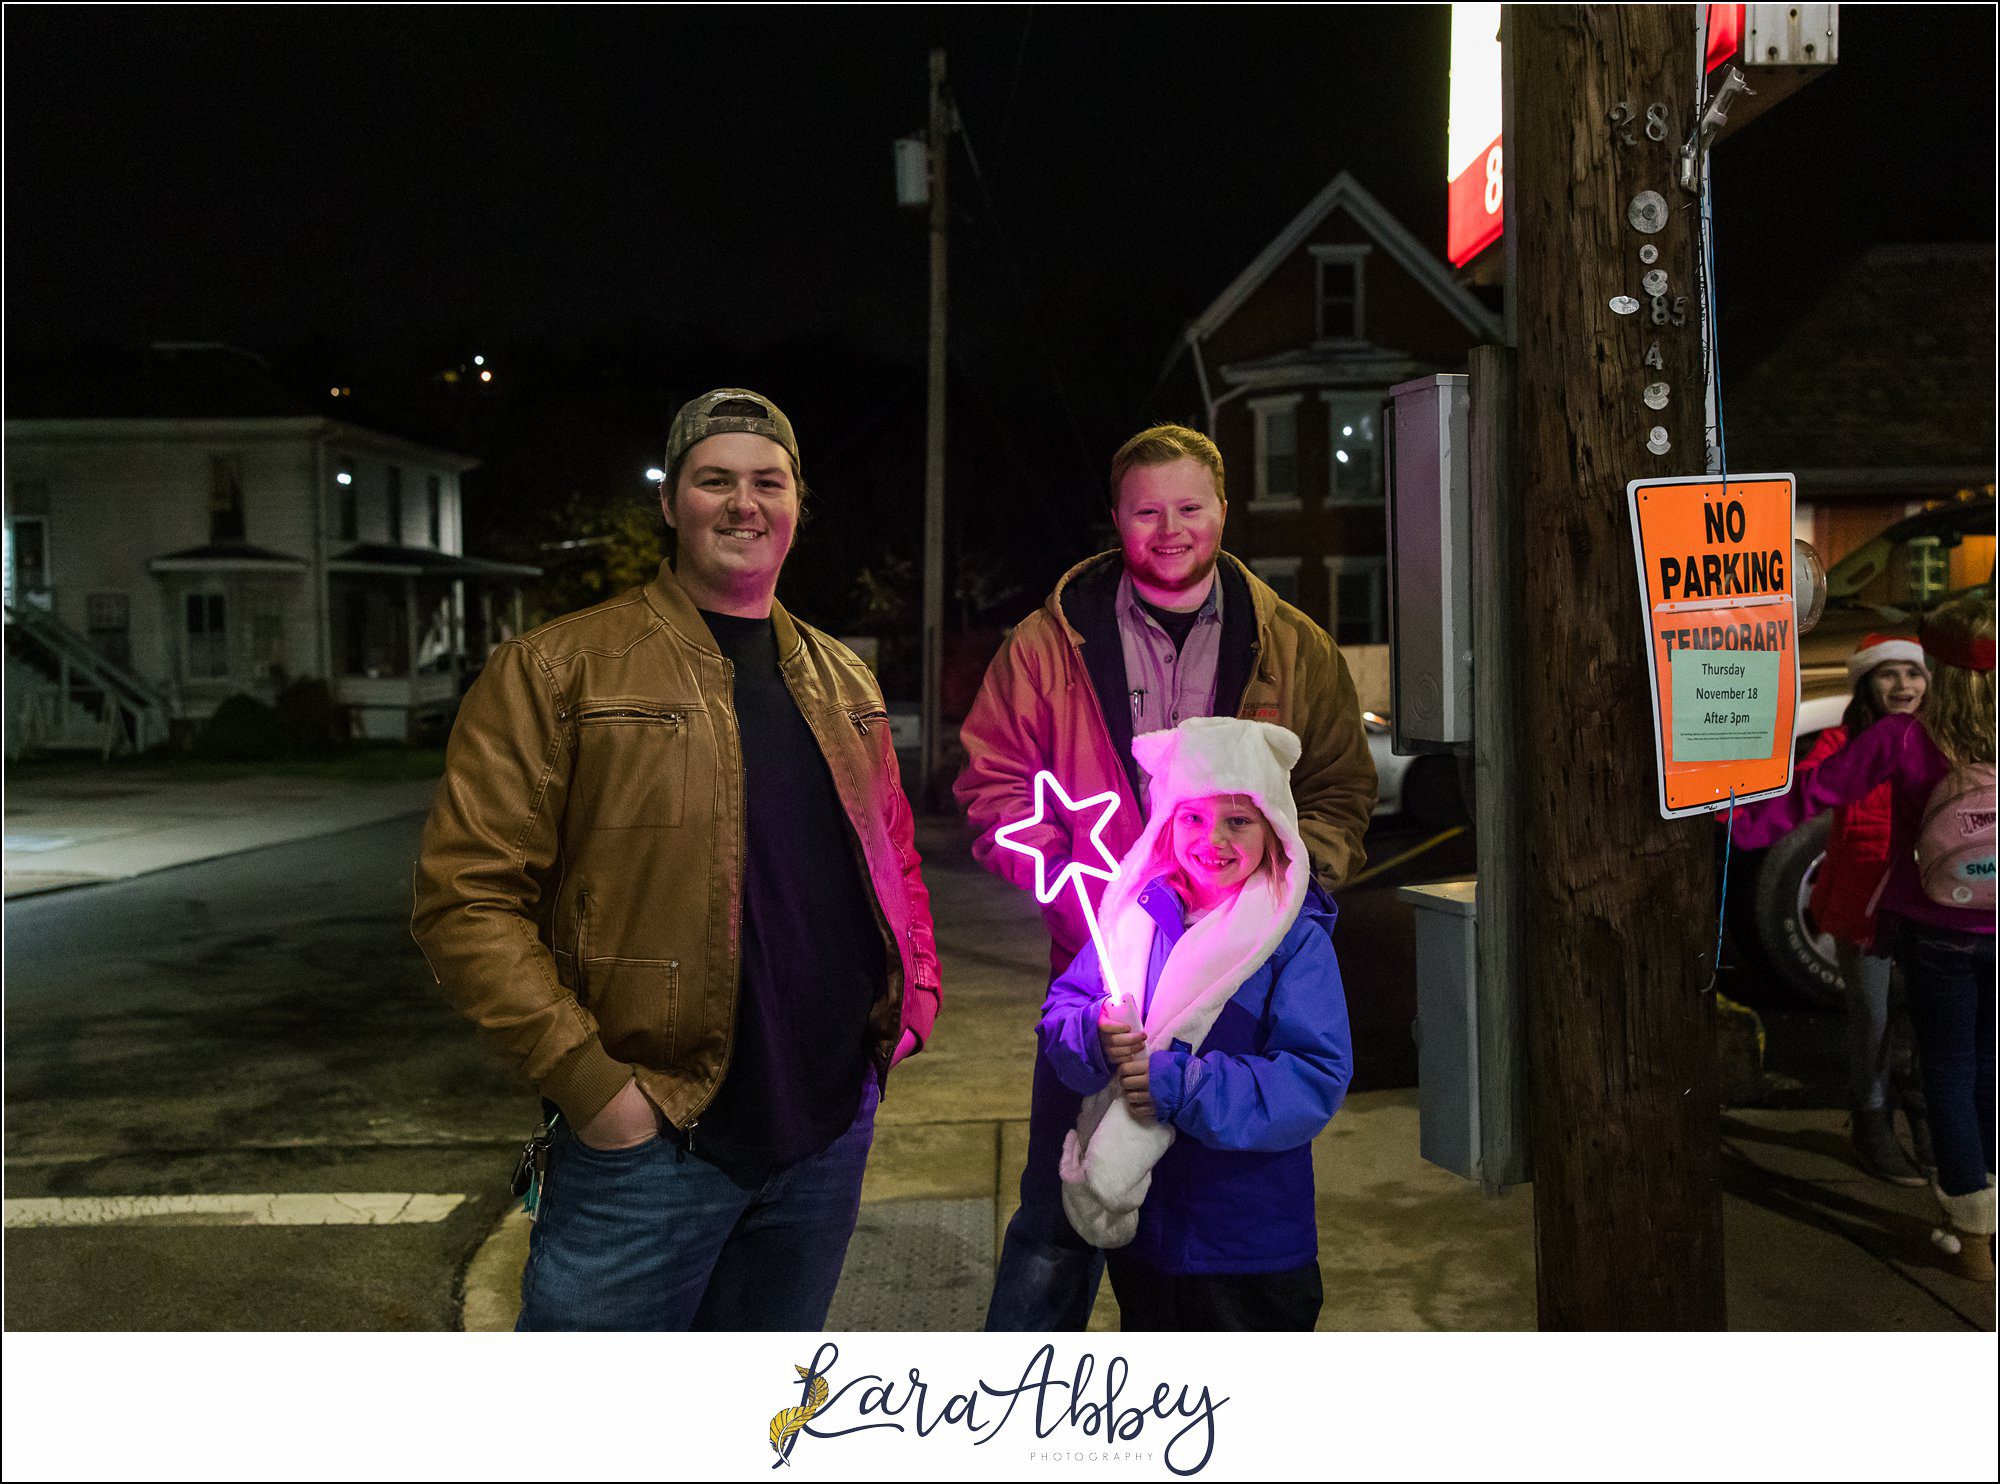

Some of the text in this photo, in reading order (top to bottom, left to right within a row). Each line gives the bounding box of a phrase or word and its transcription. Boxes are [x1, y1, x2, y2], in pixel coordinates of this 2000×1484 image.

[1485, 145, 1503, 214] 8
[1704, 500, 1746, 544] NO
[1660, 549, 1784, 600] PARKING
[1661, 619, 1788, 662] TEMPORARY
[1702, 663, 1746, 678] Thursday
[1696, 687, 1758, 700] November 18
[1704, 711, 1750, 726] After 3pm
